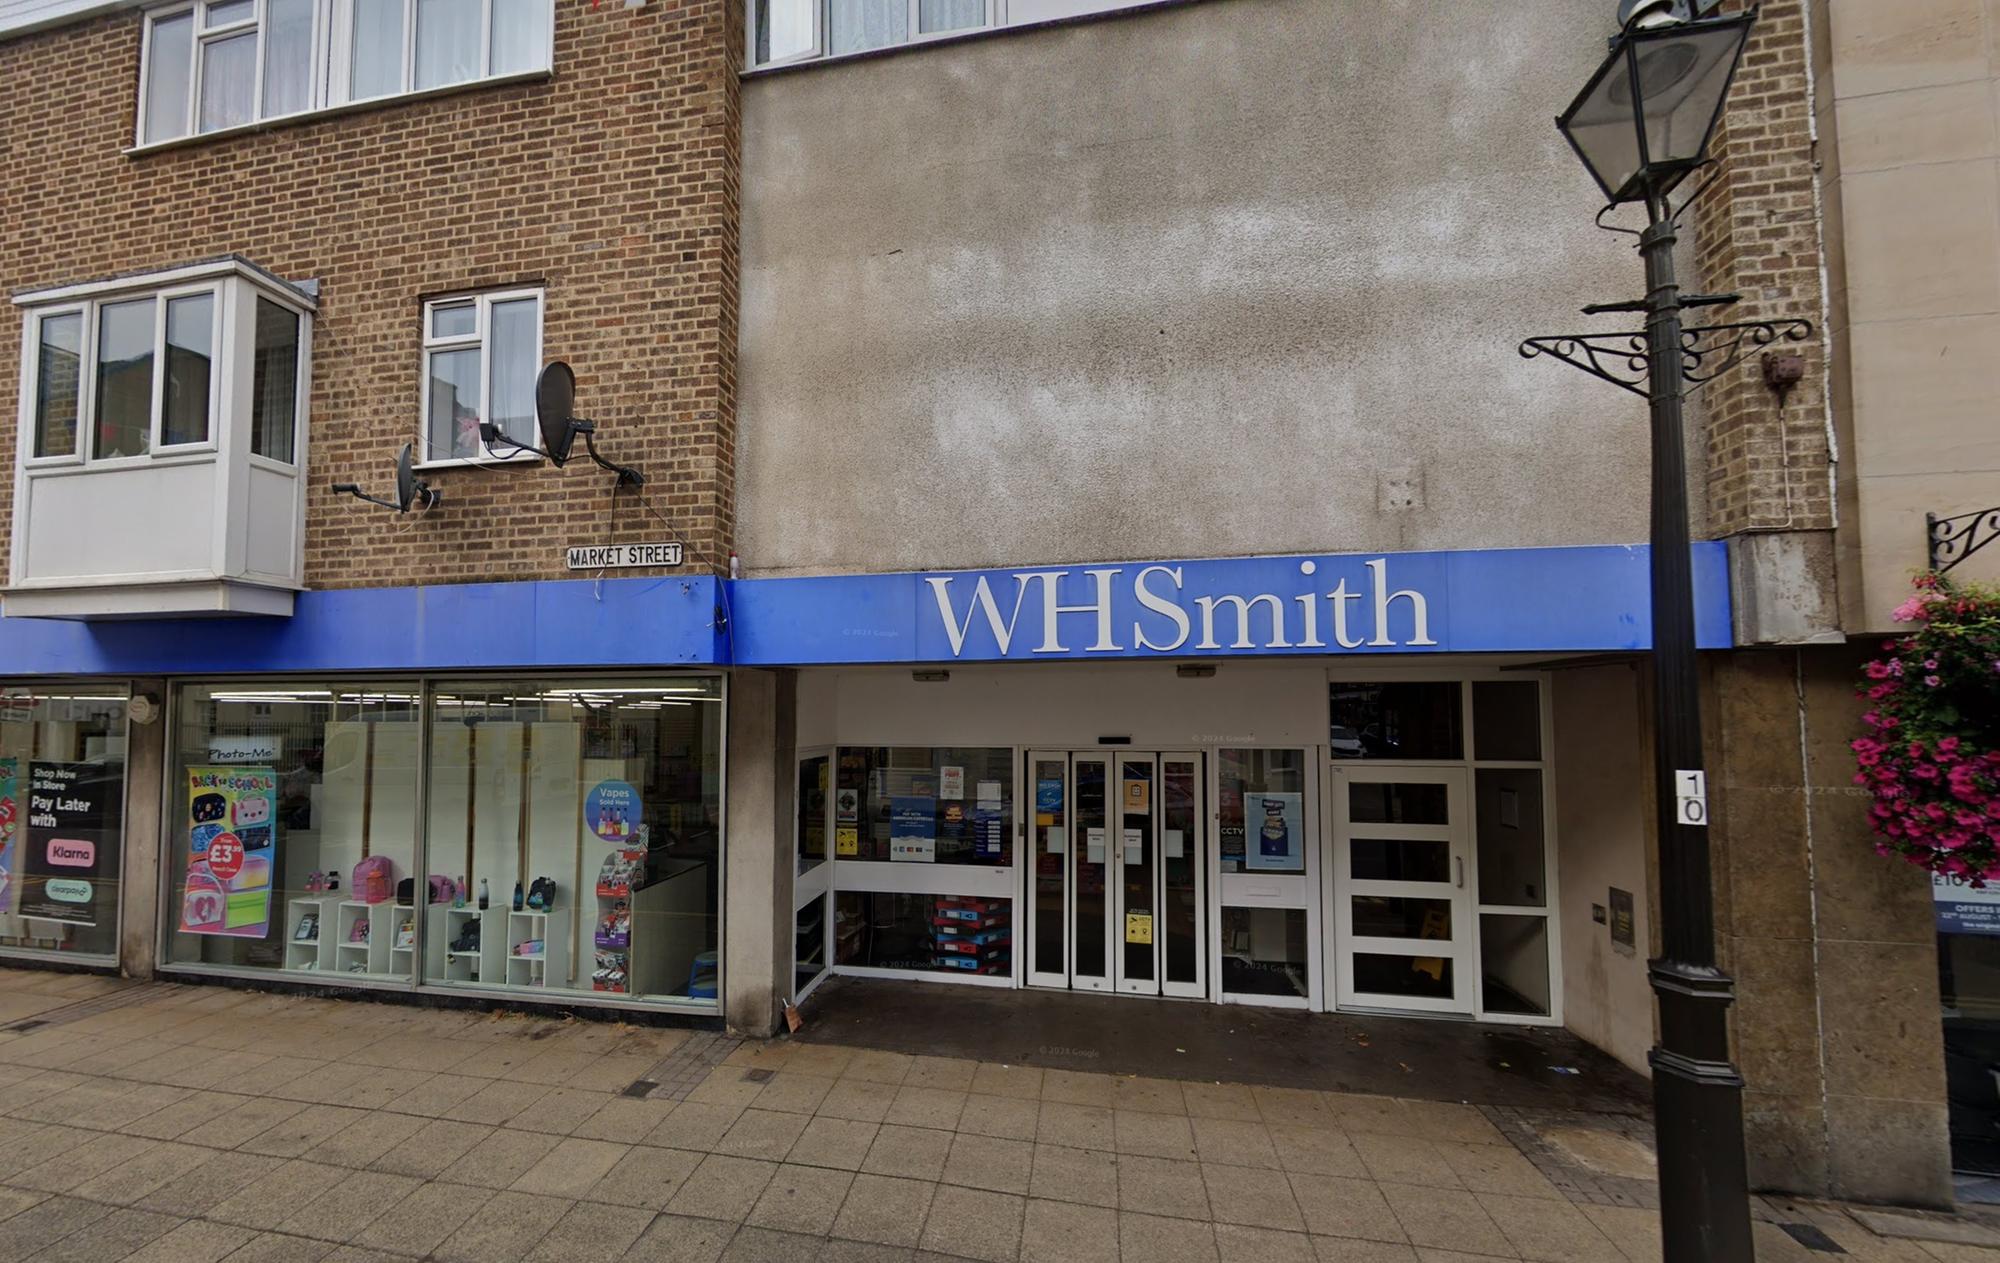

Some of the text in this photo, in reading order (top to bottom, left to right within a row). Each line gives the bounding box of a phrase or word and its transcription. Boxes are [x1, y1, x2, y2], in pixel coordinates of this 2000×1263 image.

[570, 545, 679, 566] MARKET STREET
[925, 558, 1438, 657] WHSmith
[208, 748, 273, 759] Photo-Me
[34, 768, 76, 779] Shop Now
[42, 781, 66, 790] Store
[192, 772, 218, 788] BACK
[228, 774, 273, 792] SCHOOL
[600, 788, 630, 798] Vapes
[32, 796, 91, 811] Pay Later
[30, 814, 56, 827] with
[1221, 827, 1244, 835] CCTV
[53, 846, 90, 859] Klarna
[1955, 904, 1995, 914] OFFERS
